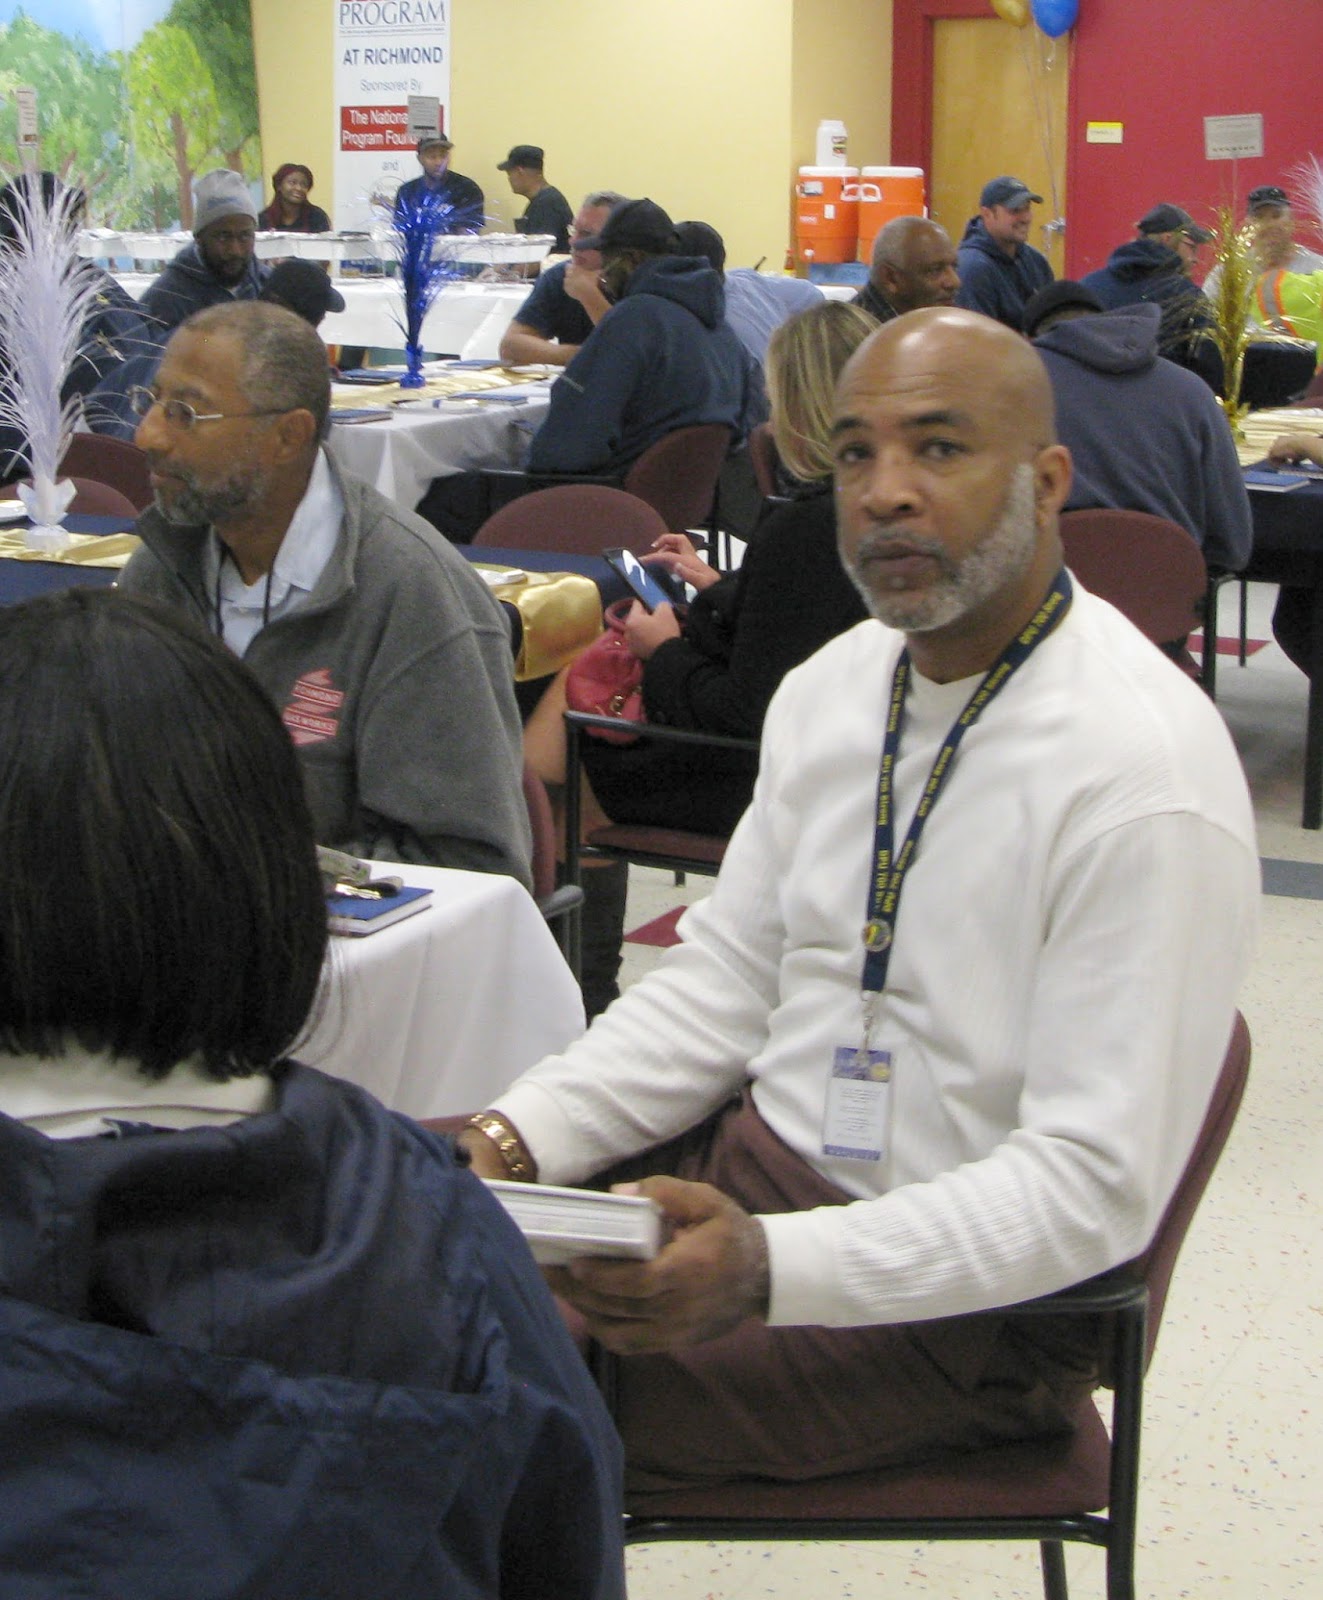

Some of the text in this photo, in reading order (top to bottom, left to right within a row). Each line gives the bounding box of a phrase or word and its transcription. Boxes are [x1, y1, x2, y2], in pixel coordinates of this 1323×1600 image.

[339, 1, 446, 25] PROGRAM
[343, 46, 443, 65] AT RICHMOND
[360, 78, 422, 93] Sponsored By
[349, 109, 368, 125] The
[370, 110, 409, 125] Nationa
[342, 130, 384, 149] Program
[382, 161, 399, 171] and
